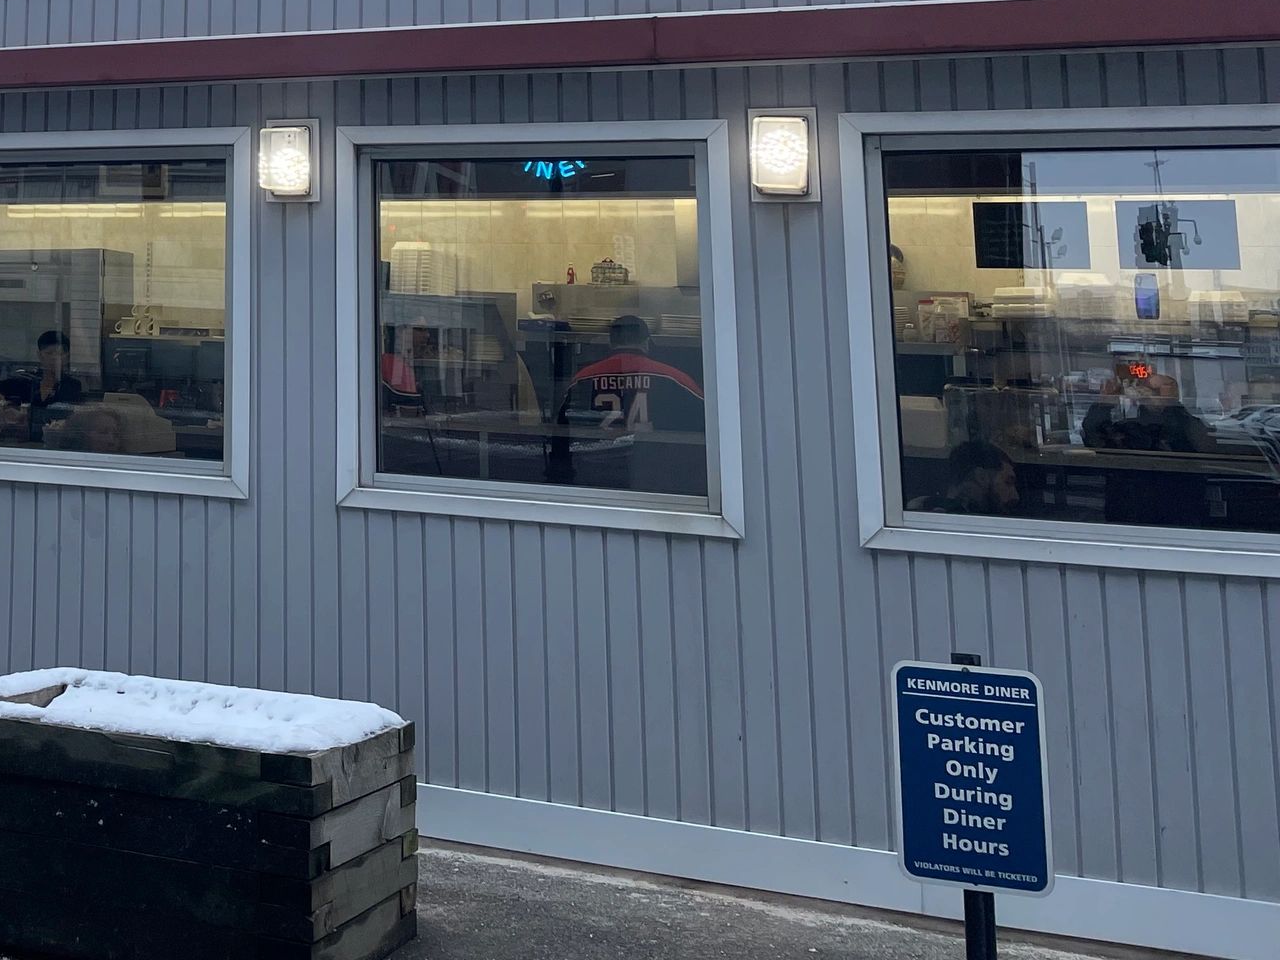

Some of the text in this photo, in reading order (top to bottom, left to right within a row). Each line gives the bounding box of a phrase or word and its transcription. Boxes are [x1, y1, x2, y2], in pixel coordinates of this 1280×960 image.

[593, 375, 651, 391] TOSCANO
[594, 391, 654, 432] 24
[907, 678, 1030, 700] KENMORE DINER
[915, 708, 1025, 734] Customer
[927, 733, 1015, 761] Parking
[946, 760, 998, 784] Only
[934, 783, 1013, 811] During
[943, 808, 1007, 831] Diner
[942, 833, 1010, 857] Hours
[914, 861, 1038, 884] VIOLATORS WILL BE TICKETED
